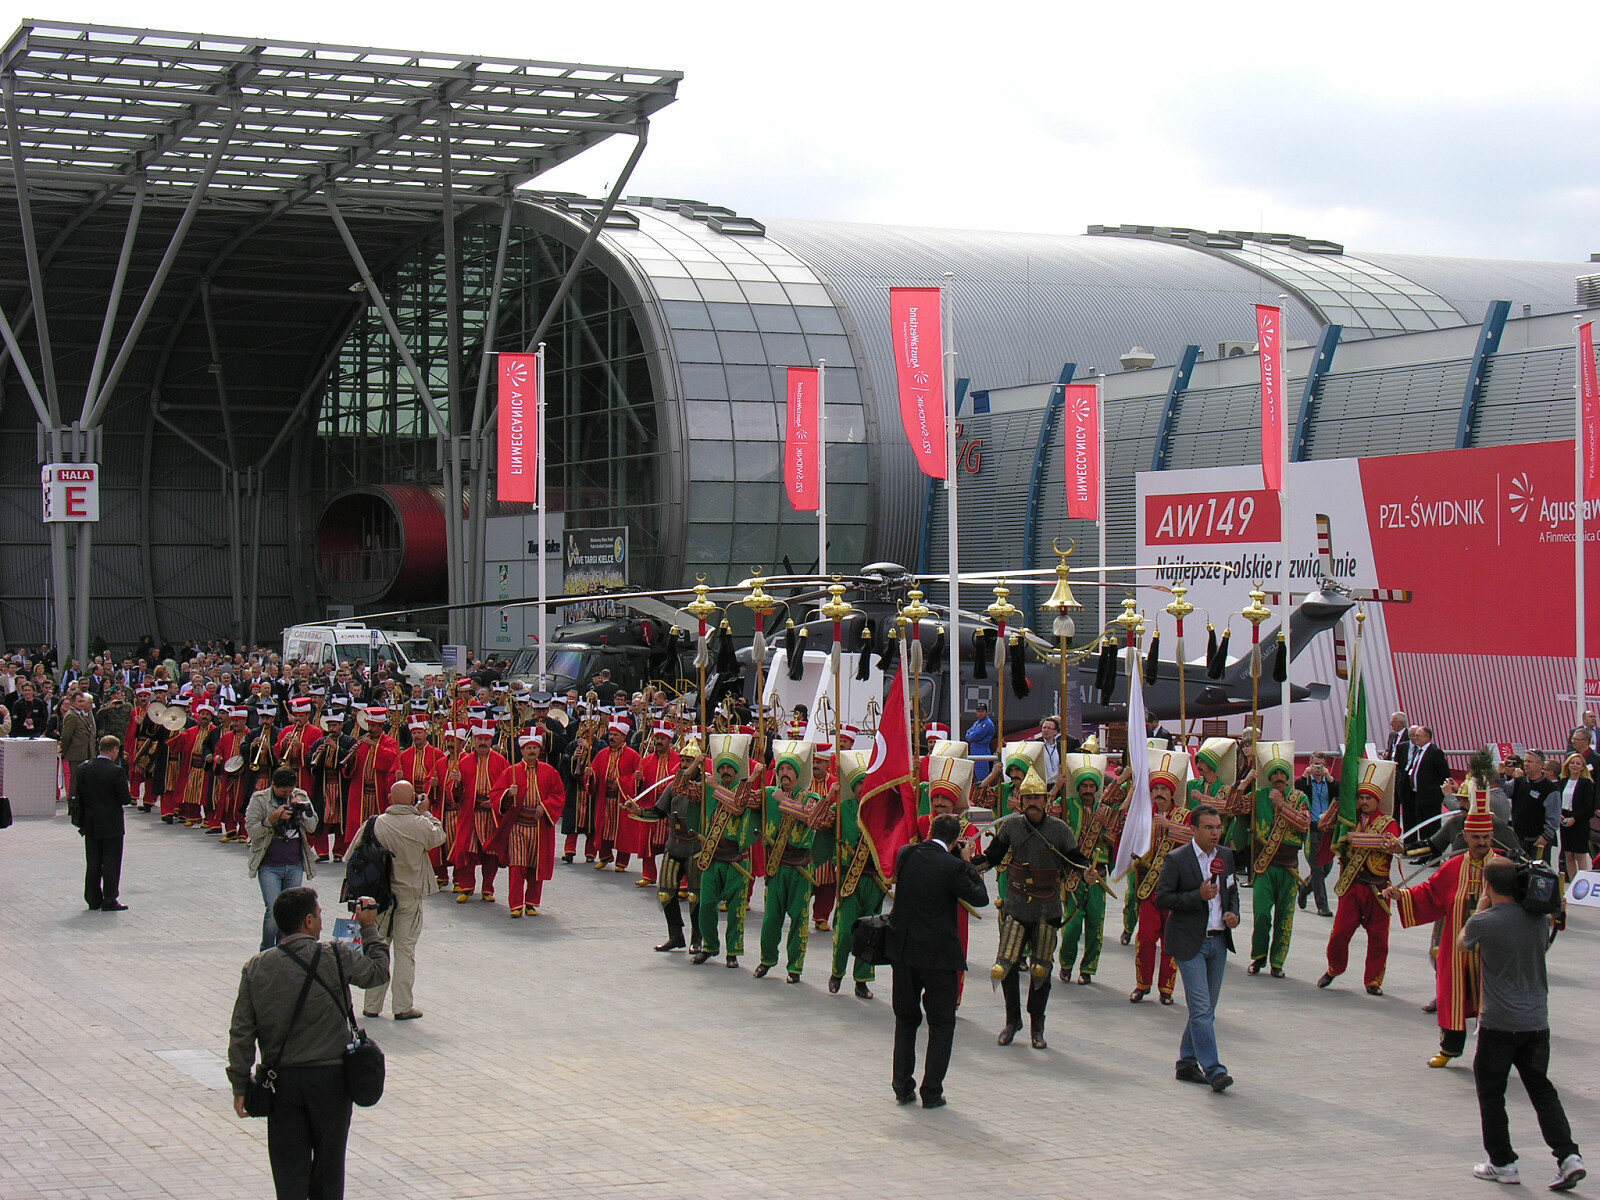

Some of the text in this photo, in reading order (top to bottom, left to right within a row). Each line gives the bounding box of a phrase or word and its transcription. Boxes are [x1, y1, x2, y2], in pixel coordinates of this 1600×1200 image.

[61, 470, 90, 480] HALA
[66, 486, 87, 516] E
[1155, 496, 1255, 538] AW149
[1379, 495, 1485, 529] PZL-ŚWIDNIK
[1539, 532, 1545, 542] A
[1546, 530, 1595, 543] Finmeccica
[574, 554, 614, 564] VIVE TARGI KIELCE
[1156, 555, 1221, 586] Najlepsze
[1223, 553, 1272, 585] polskie
[295, 631, 322, 640] CATERING
